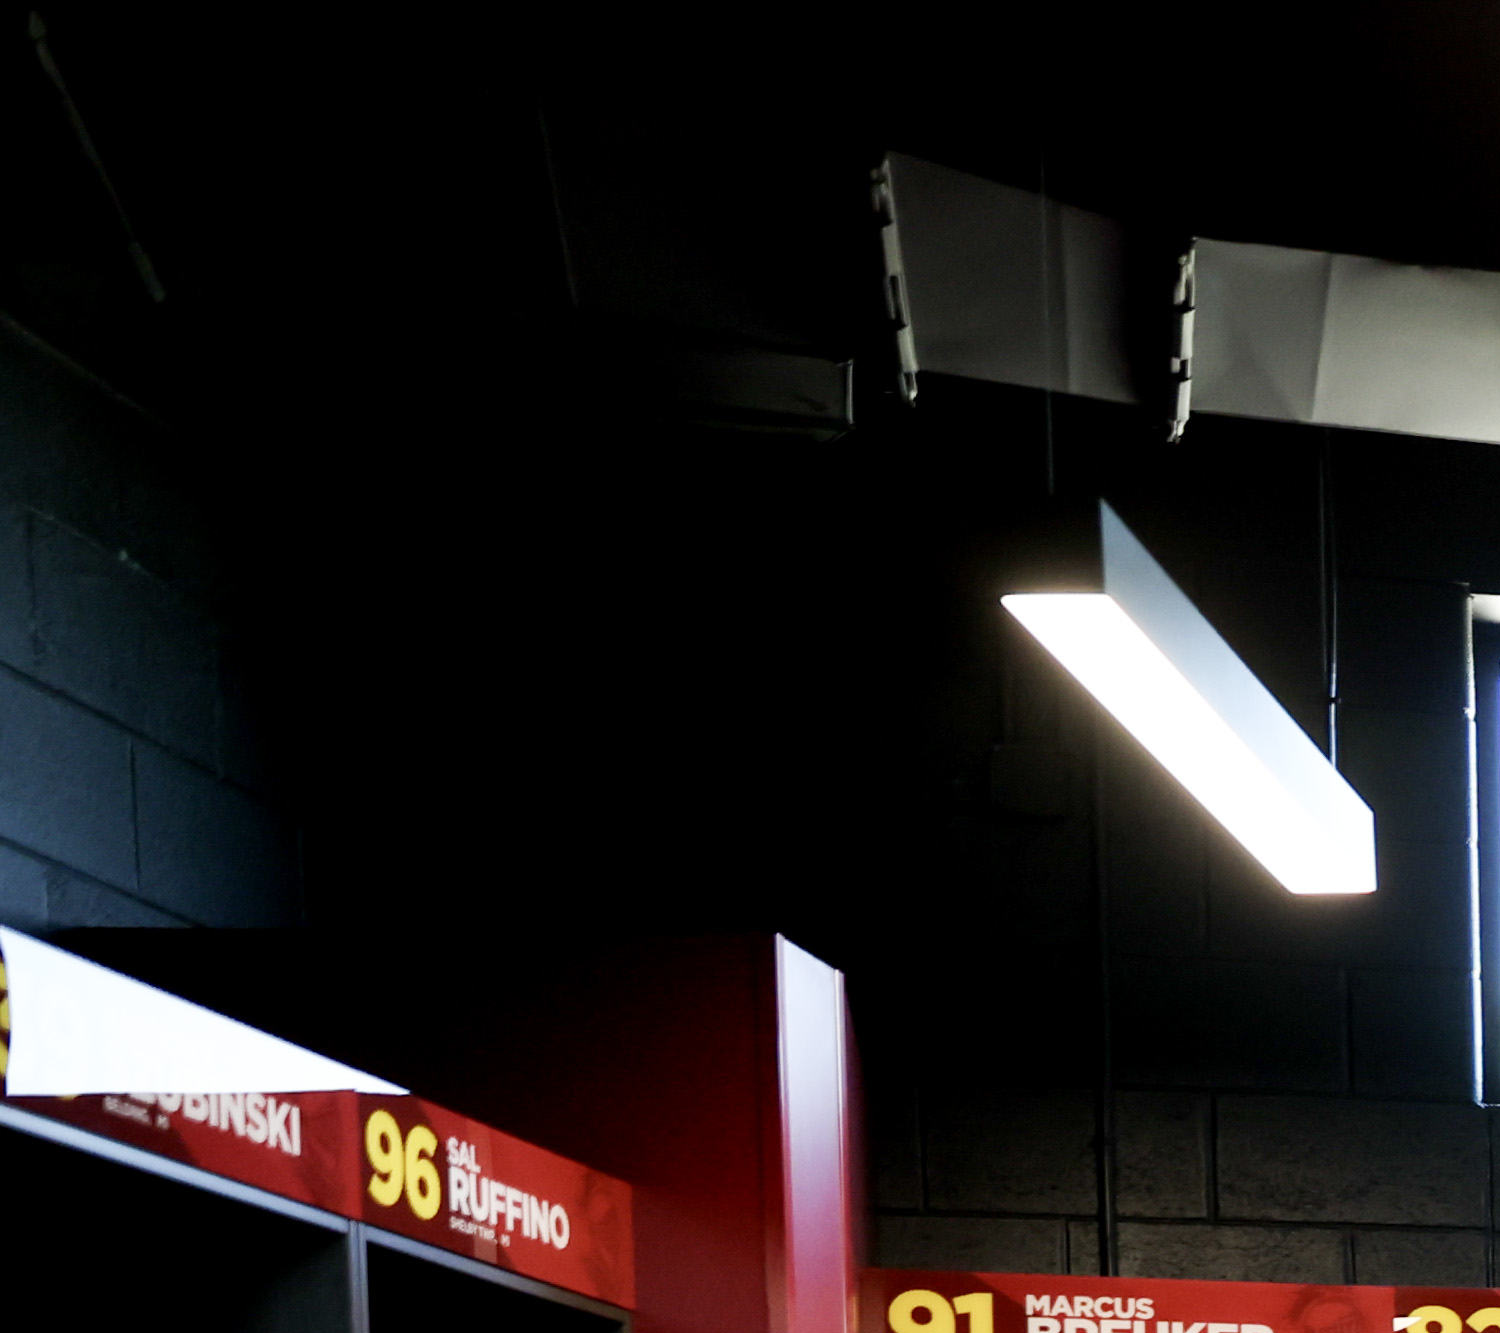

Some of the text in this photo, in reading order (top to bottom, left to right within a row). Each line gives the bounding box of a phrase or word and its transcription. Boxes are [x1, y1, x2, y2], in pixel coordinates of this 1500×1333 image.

[364, 1109, 441, 1221] 96
[446, 1136, 481, 1174] SAL
[448, 1166, 570, 1250] RUFFINO
[1026, 1294, 1154, 1319] MARCUS
